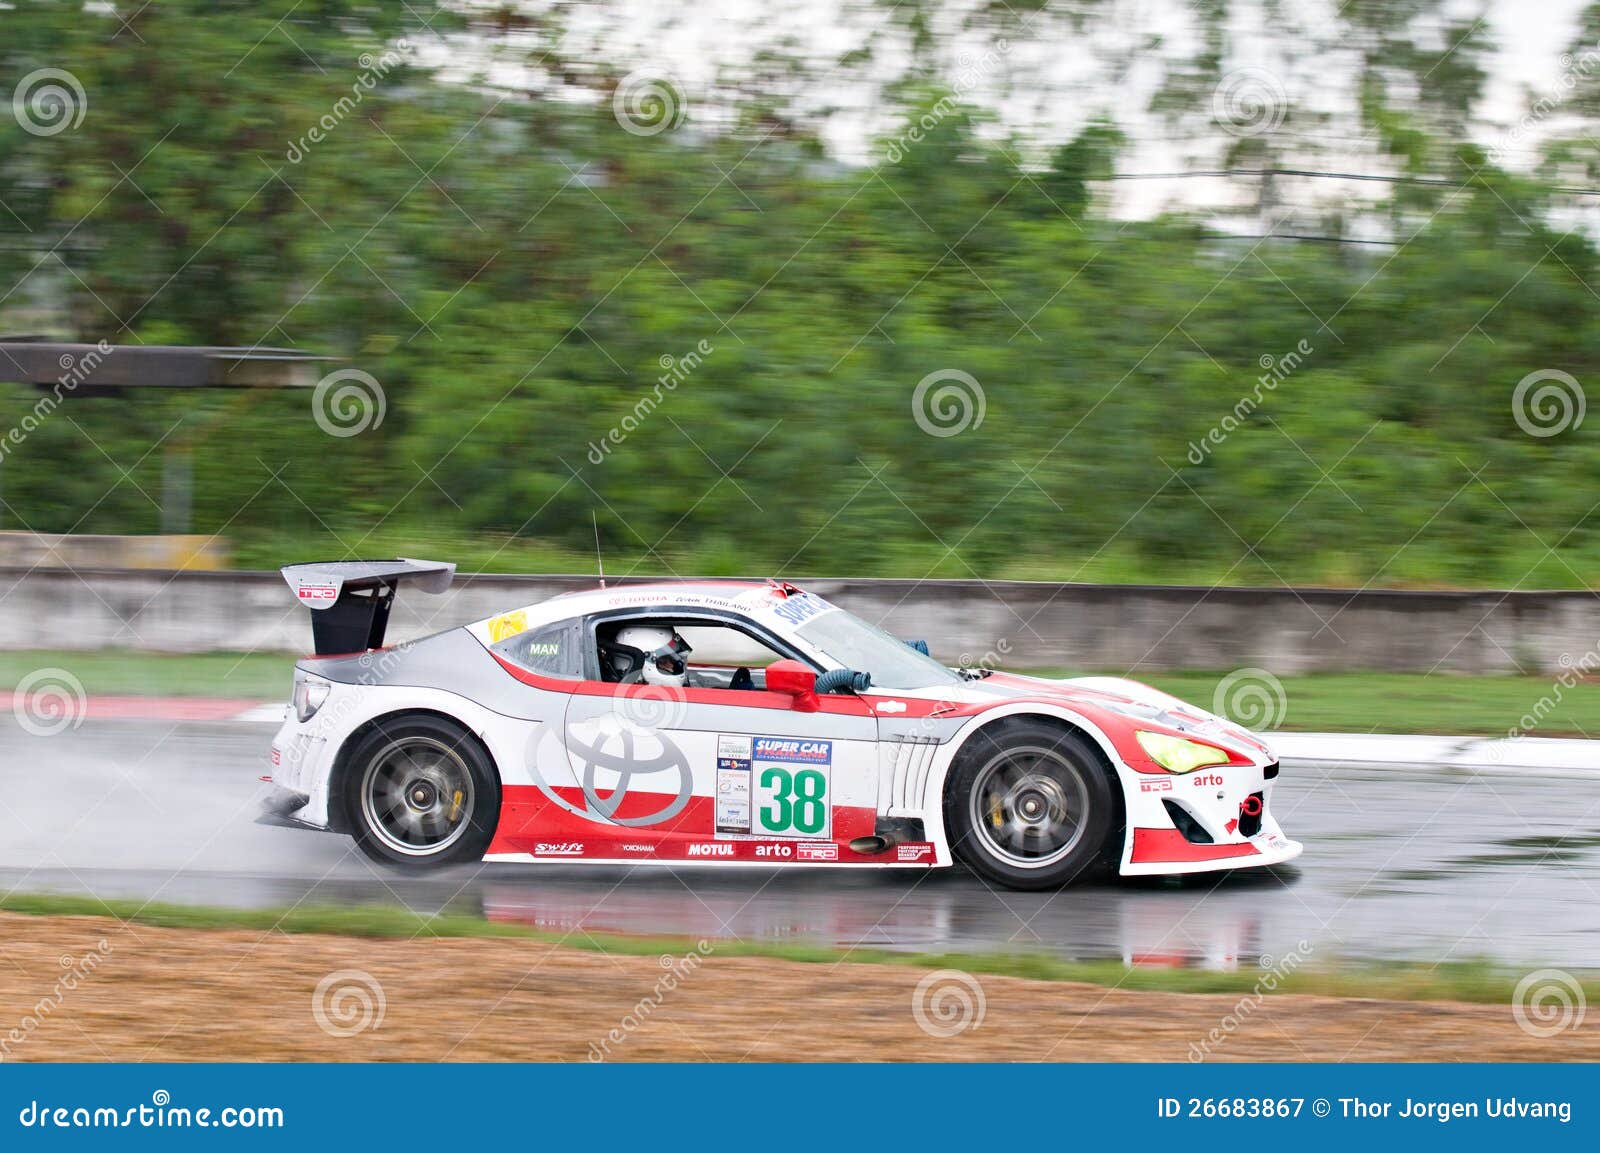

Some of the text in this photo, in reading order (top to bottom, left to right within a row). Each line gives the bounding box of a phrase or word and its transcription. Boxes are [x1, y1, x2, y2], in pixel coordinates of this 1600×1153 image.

[299, 588, 336, 598] TRD
[530, 643, 559, 656] MAN
[756, 739, 800, 753] SUPER
[800, 742, 829, 755] CAR
[1193, 773, 1223, 787] arto
[760, 767, 826, 834] 38
[623, 844, 655, 852] YOKOHAMA
[687, 843, 734, 856] MOTUL
[755, 843, 792, 857] arto
[799, 849, 837, 859] TRD
